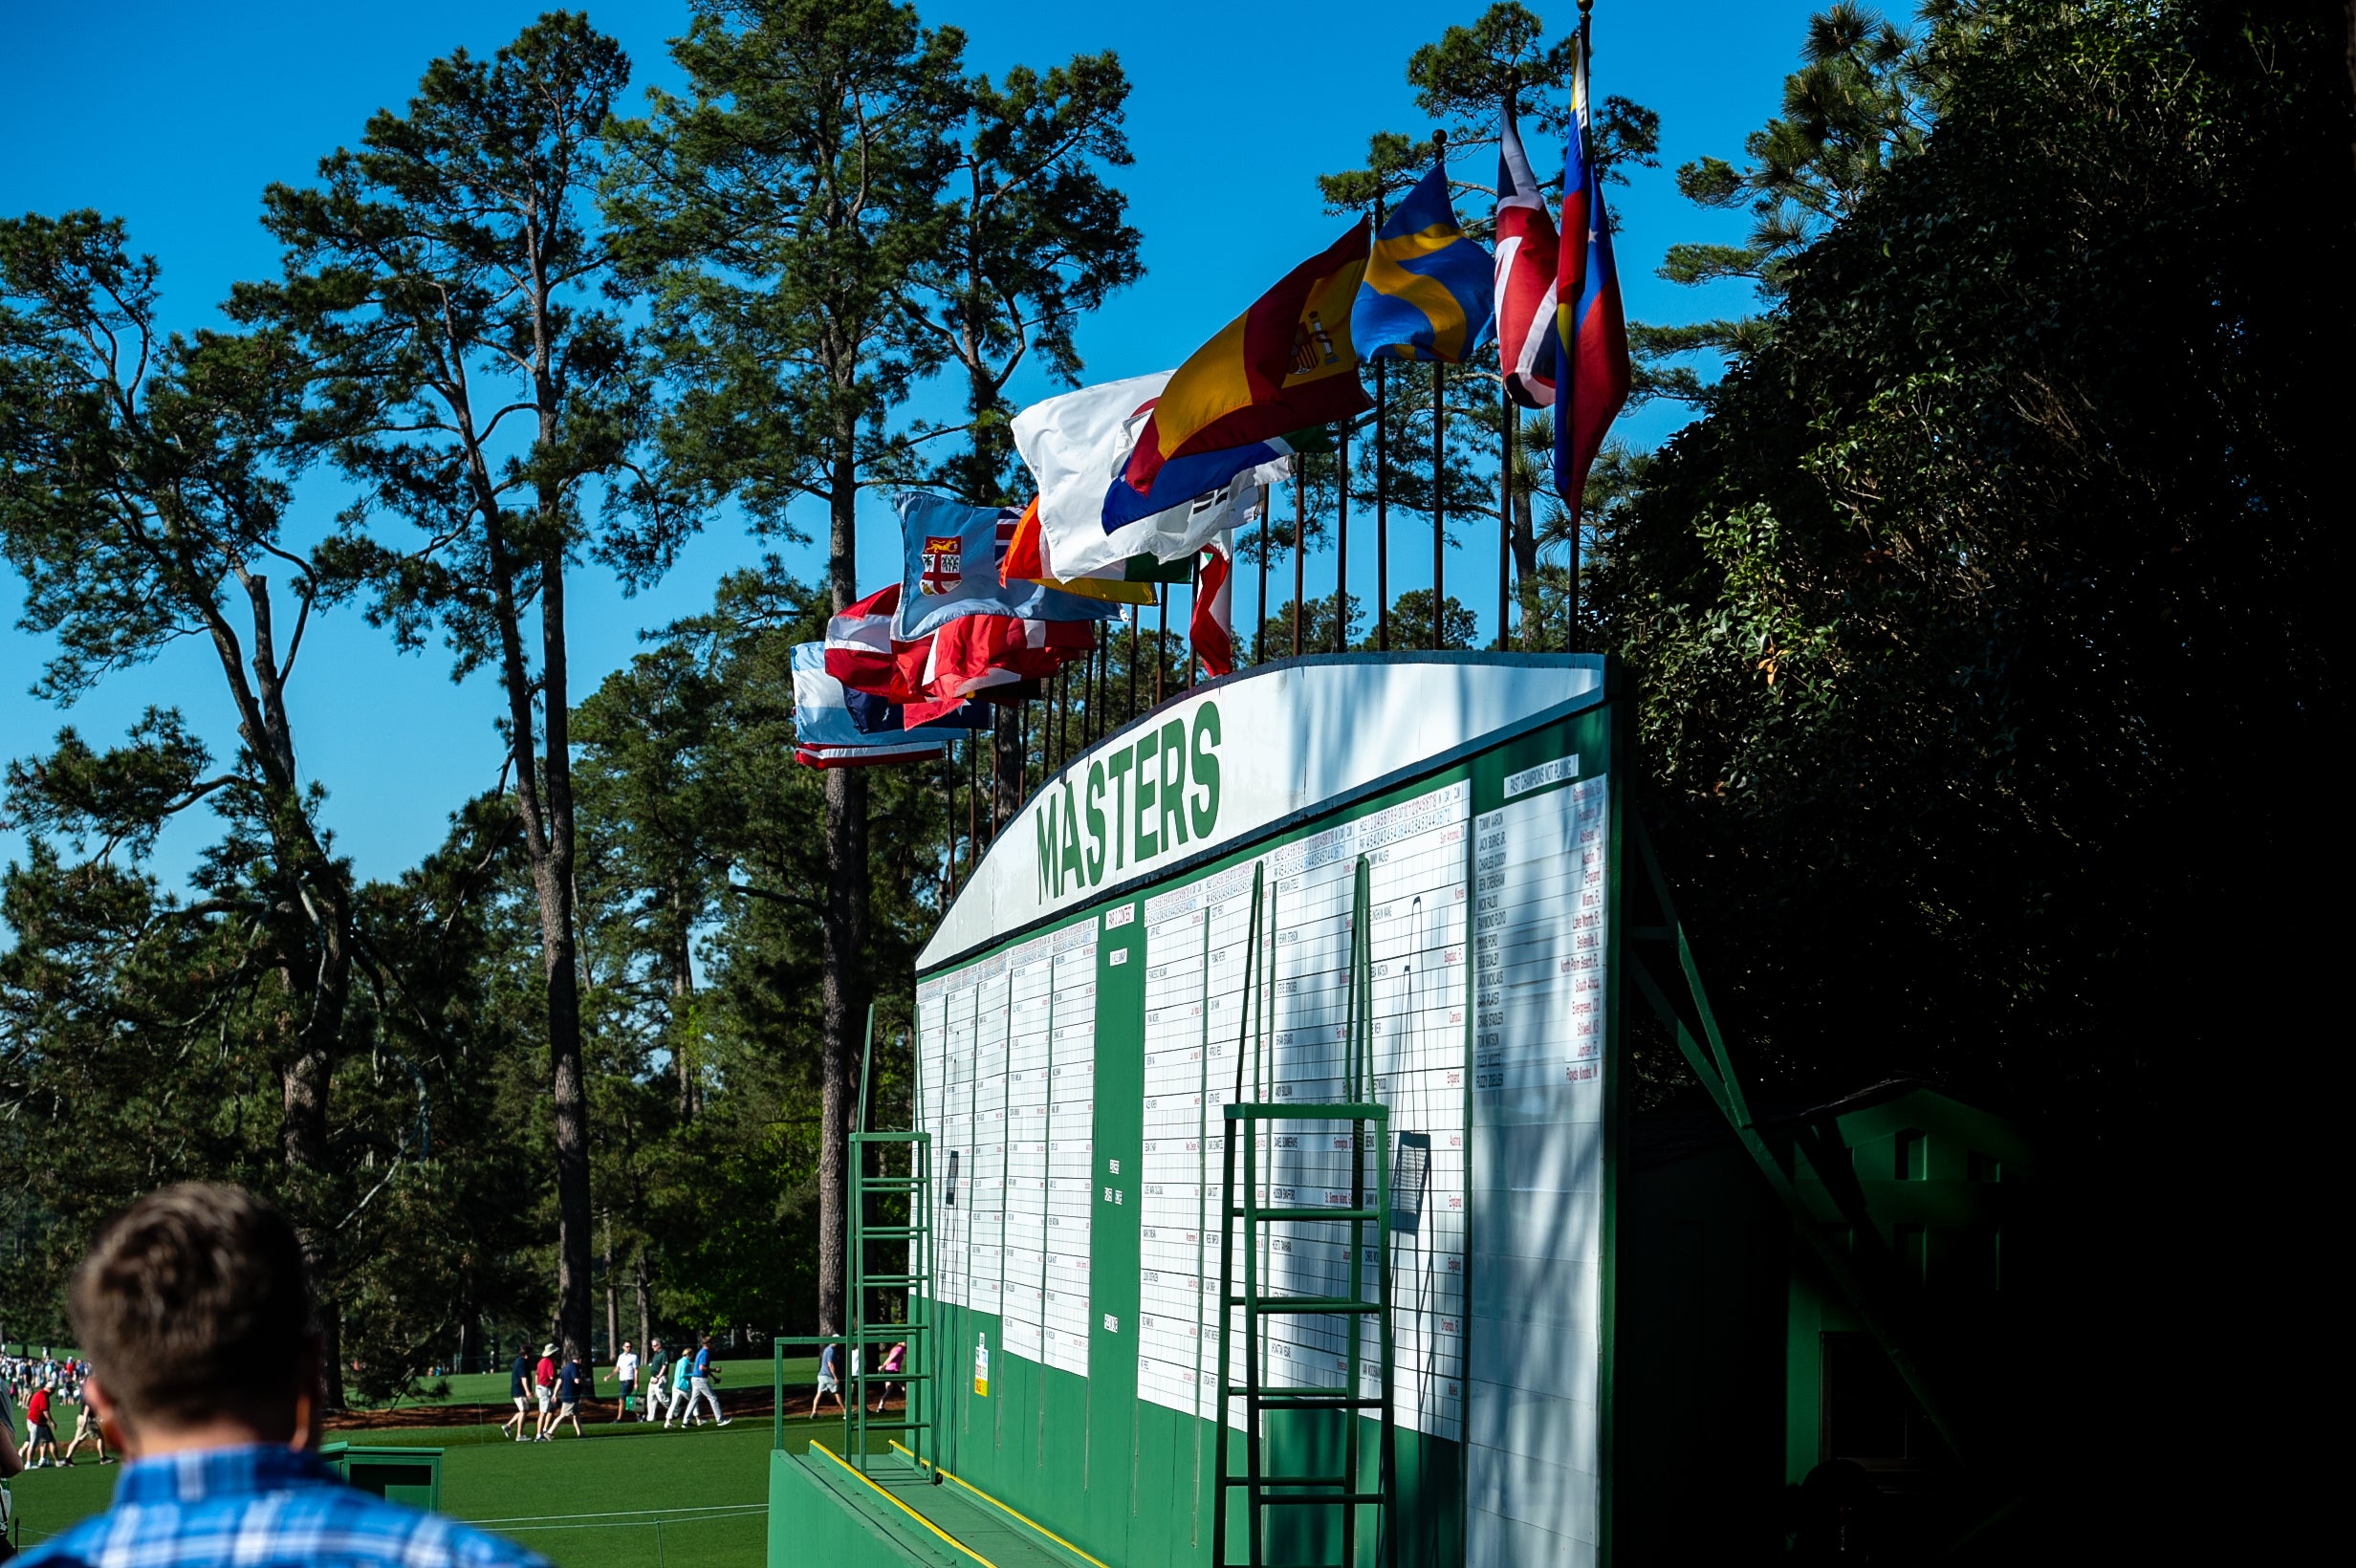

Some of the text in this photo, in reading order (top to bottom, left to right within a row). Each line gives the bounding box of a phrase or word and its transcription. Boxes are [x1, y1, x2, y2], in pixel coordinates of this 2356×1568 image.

[1510, 776, 1519, 794] PAST
[1521, 768, 1543, 791] CHAMPIONS
[1544, 765, 1553, 783] NOT
[1036, 700, 1221, 905] MASTERS
[1478, 812, 1503, 831] TOMMY AARON
[1478, 838, 1488, 851] JACK
[1488, 833, 1500, 849] BURKE
[1487, 872, 1505, 889] CRENSHAW
[1585, 867, 1601, 886] England
[1478, 895, 1498, 911] NICK FALDO
[1477, 910, 1506, 929] RAYMOND FLOYD
[1488, 933, 1498, 947] FORD
[1477, 970, 1503, 988] JACK NICKLAUS
[1477, 1012, 1503, 1028] CRAIG STADLER
[1485, 1033, 1499, 1047] WATSON
[1476, 1073, 1503, 1088] FUZZY ZOELLER
